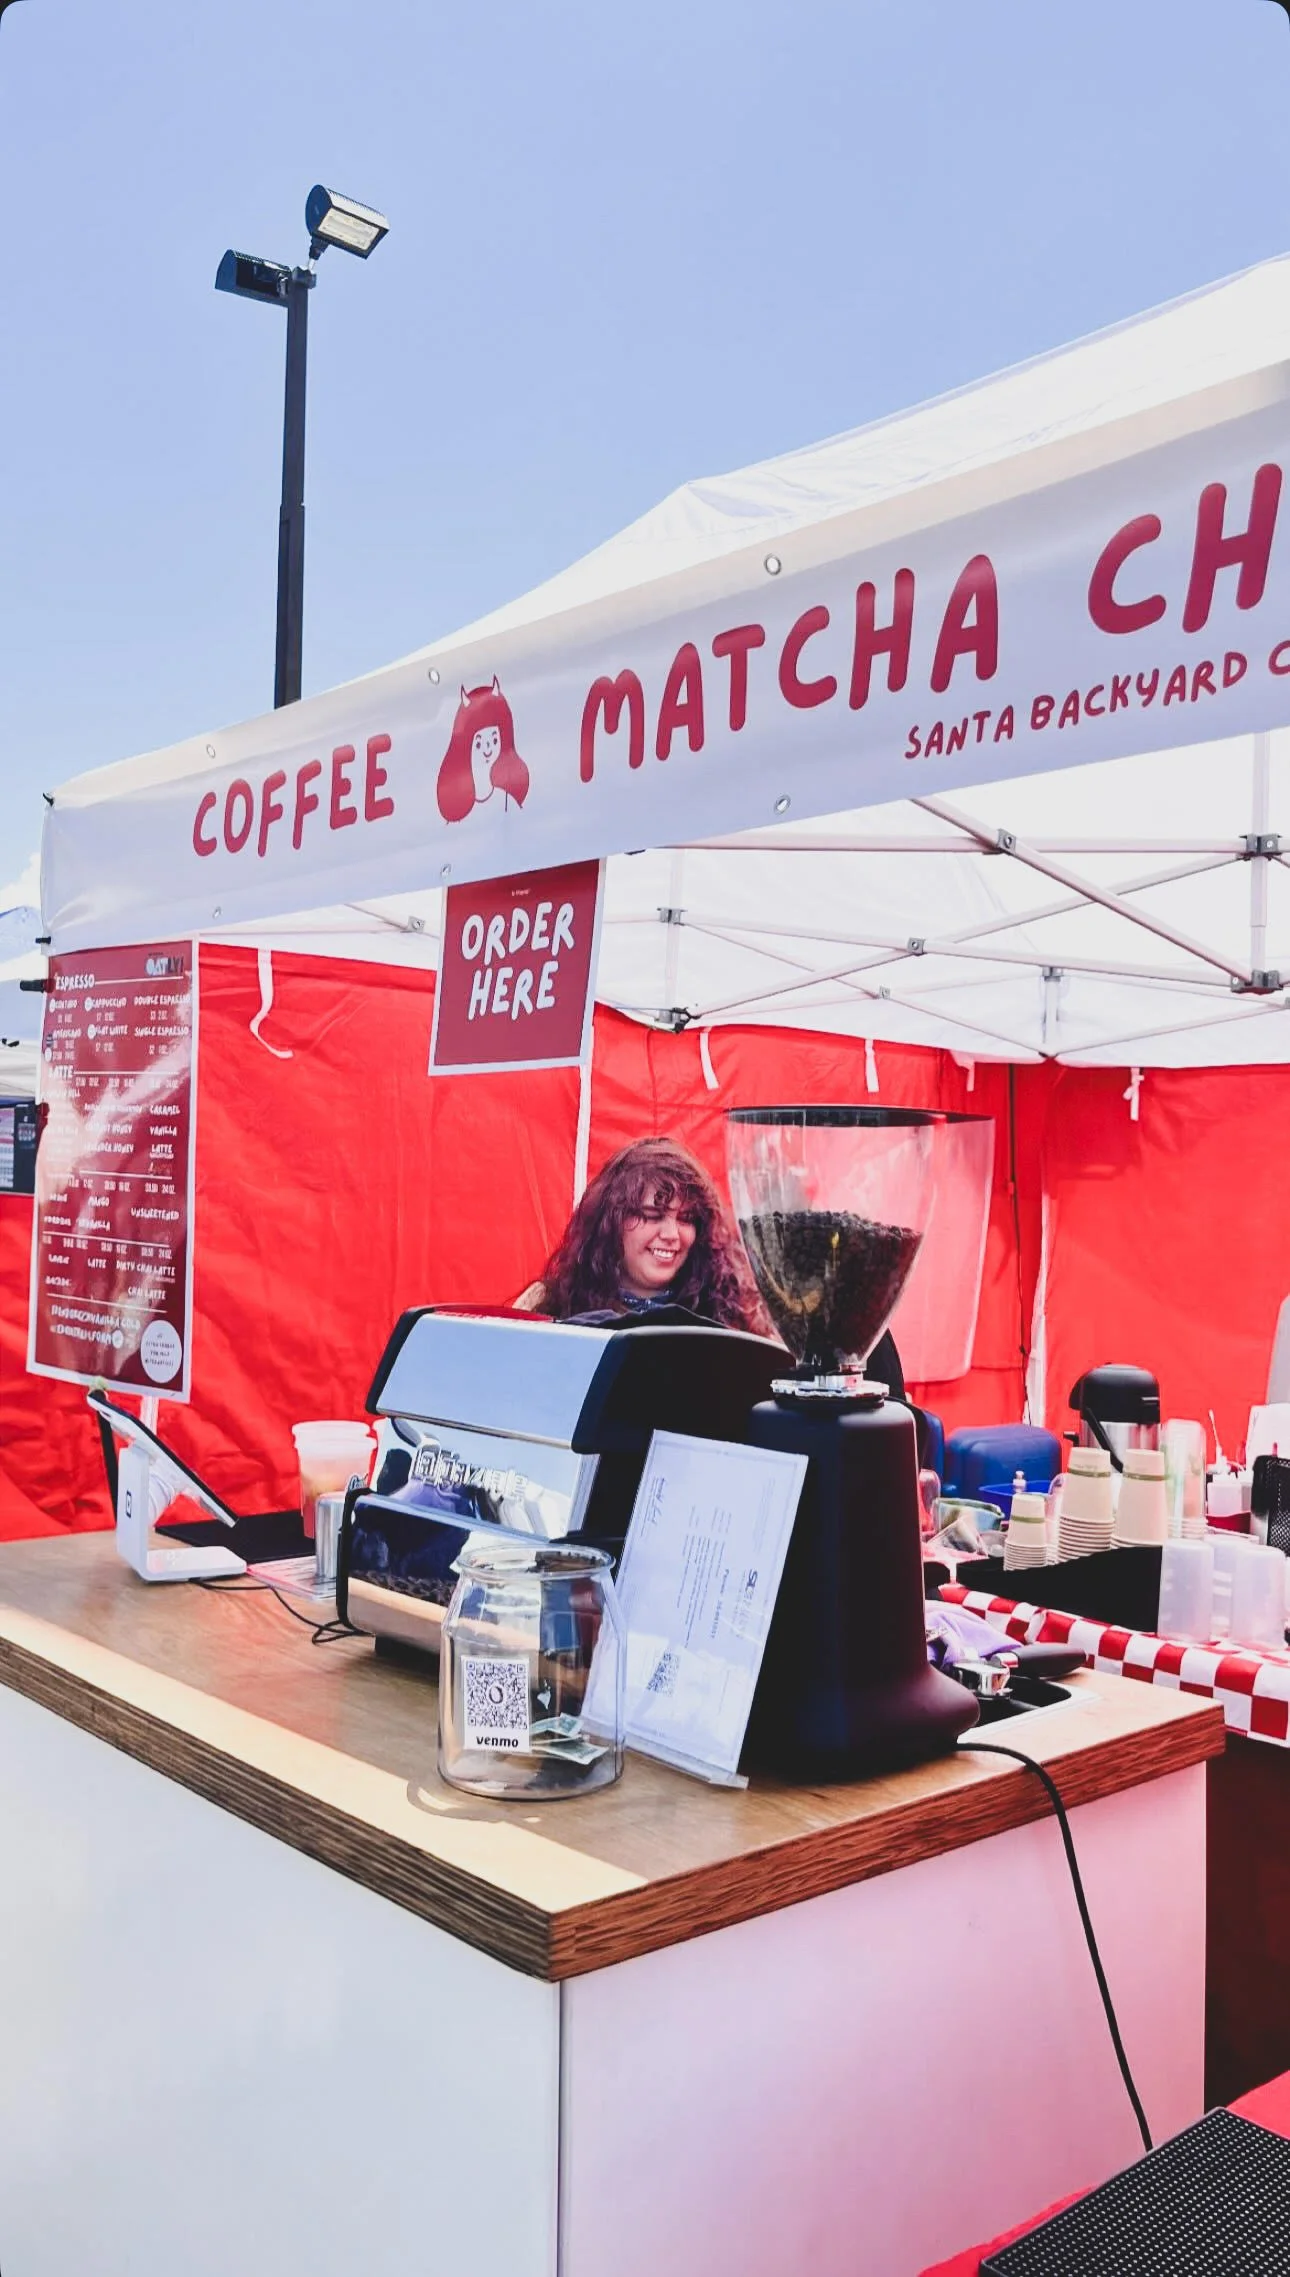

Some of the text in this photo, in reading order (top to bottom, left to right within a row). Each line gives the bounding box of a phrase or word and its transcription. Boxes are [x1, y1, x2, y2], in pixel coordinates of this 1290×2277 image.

[193, 733, 395, 857] COFFEE
[580, 554, 999, 783] MATCHA
[904, 704, 1014, 760] SANTA
[1030, 651, 1248, 731] BACKYARD
[461, 901, 575, 966] ORDER
[55, 974, 95, 991] ESPRESSO
[468, 960, 559, 1021] HERE
[49, 1065, 74, 1079] LATTE
[149, 1104, 181, 1117] CARAMEL
[149, 1126, 178, 1138] VANILLA
[151, 1143, 173, 1153] LATTE
[130, 1207, 180, 1220] UNSWEETENED
[476, 1735, 519, 1748] venmo
